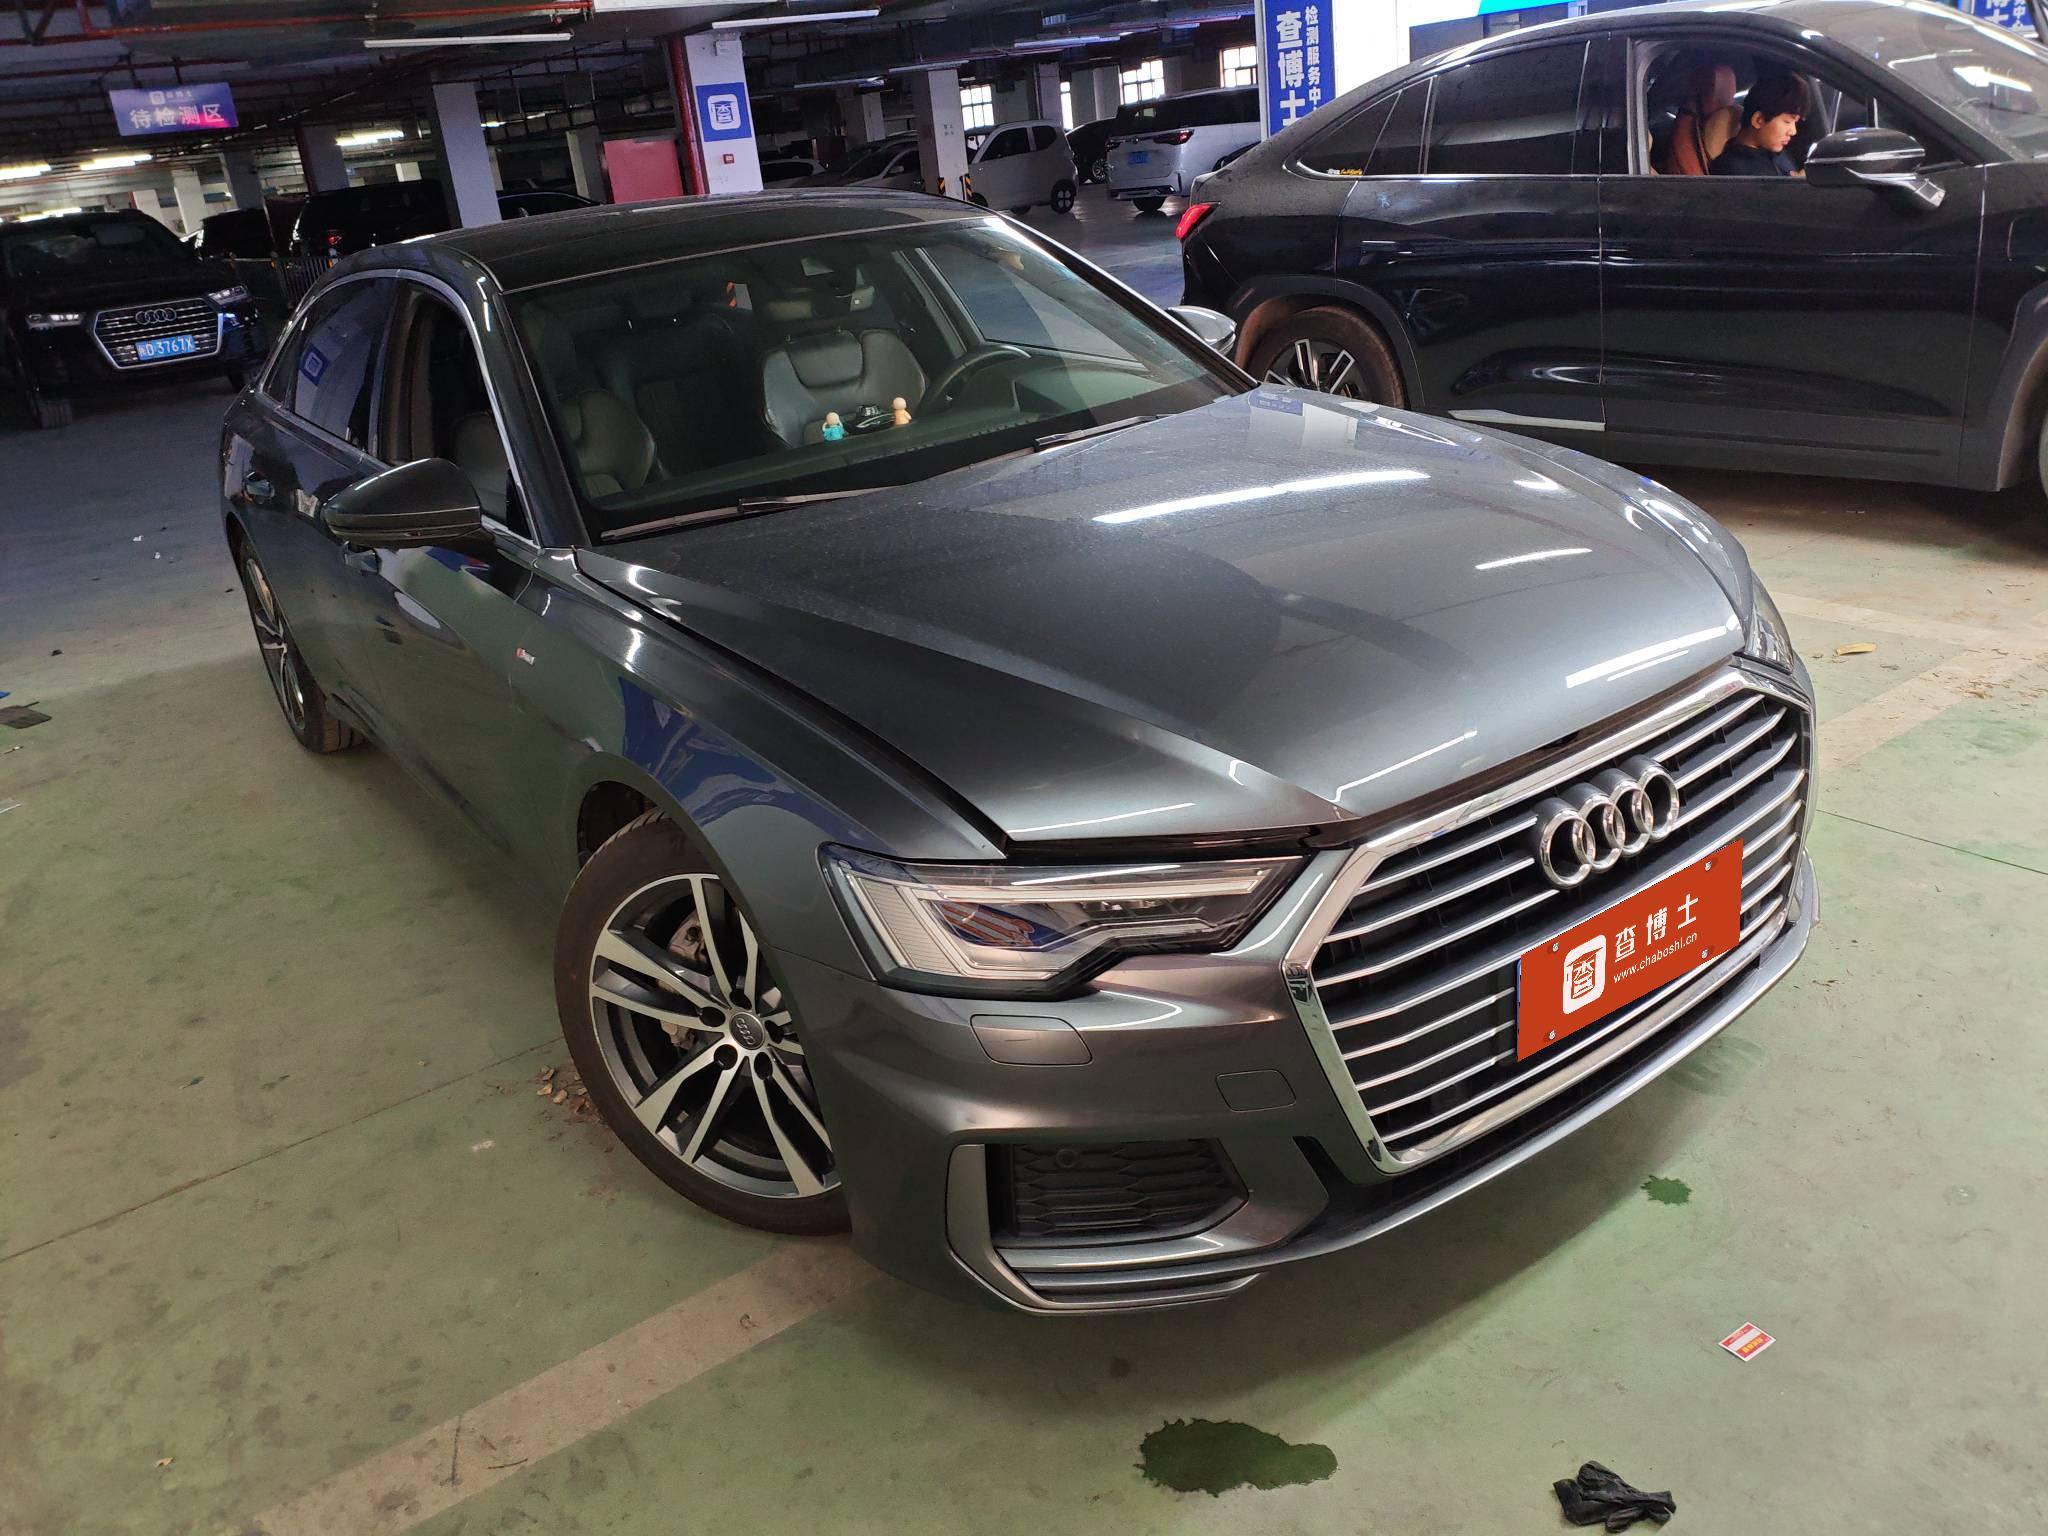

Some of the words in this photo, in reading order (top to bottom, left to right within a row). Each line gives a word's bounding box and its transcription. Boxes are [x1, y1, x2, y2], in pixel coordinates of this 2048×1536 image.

[1276, 10, 1305, 126] 查博士
[1305, 4, 1321, 111] 检测服务中
[129, 103, 225, 129] 待检测区
